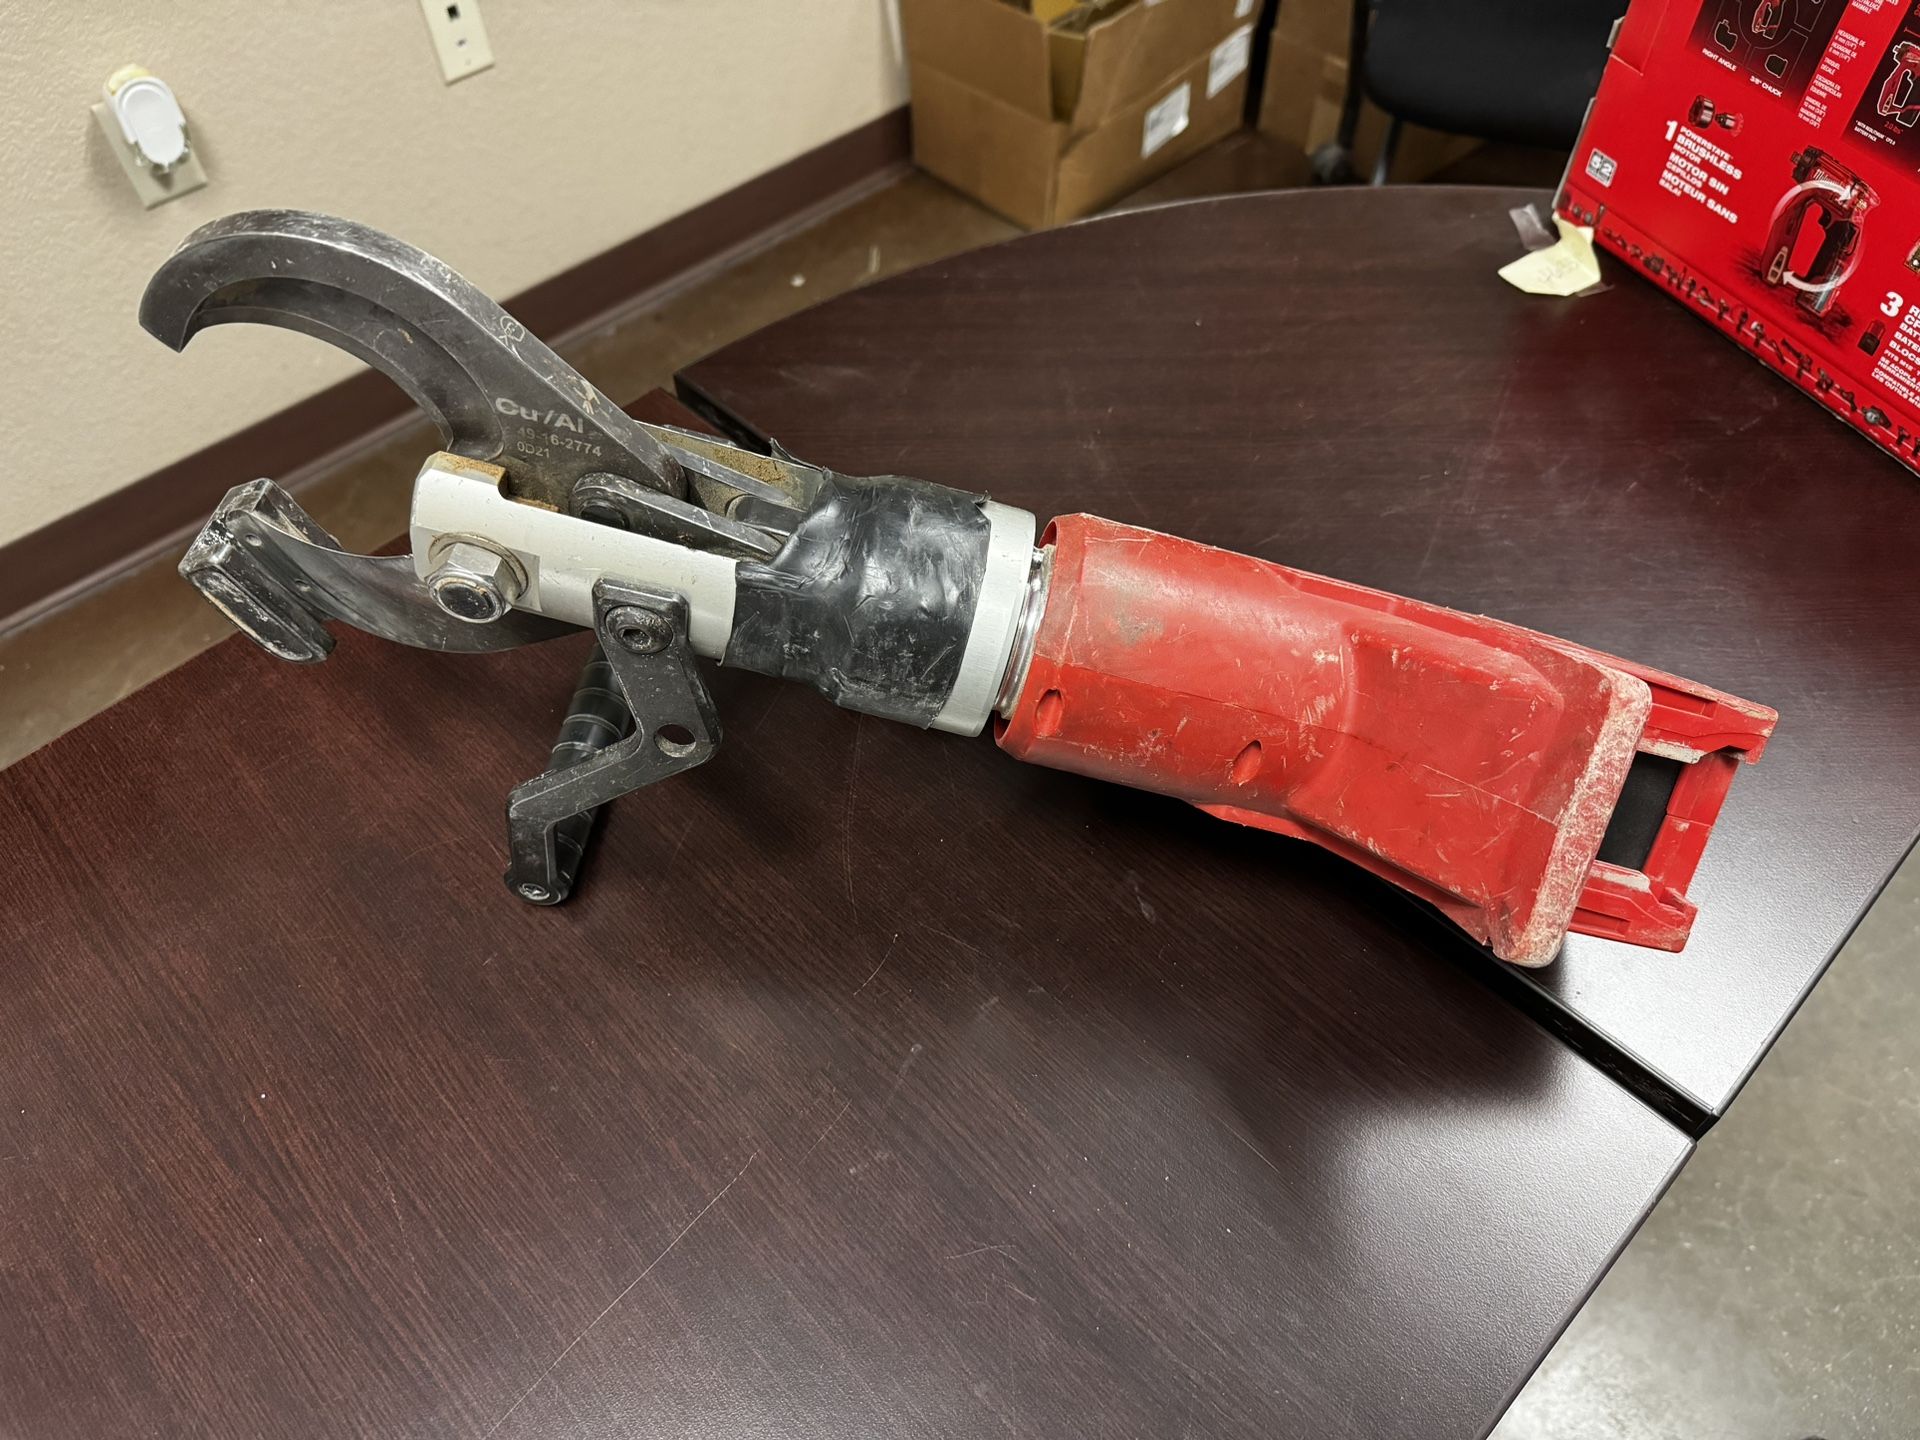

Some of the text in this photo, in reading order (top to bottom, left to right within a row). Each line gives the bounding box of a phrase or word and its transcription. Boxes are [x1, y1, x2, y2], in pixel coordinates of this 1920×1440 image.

[1702, 48, 1737, 72] RIGHT ANGLE
[1761, 82, 1782, 97] CHUCK
[1664, 120, 1678, 141] 1
[1673, 143, 1701, 164] MOTOR
[1676, 134, 1742, 180] BRUSHLESS
[1666, 161, 1702, 188] CEPILLOS
[1668, 152, 1729, 195] MOTOR SIN
[1659, 179, 1682, 197] BALAI
[1661, 169, 1738, 224] MOTEUR SANS
[1880, 291, 1904, 317] 3
[1884, 349, 1899, 362] FITS
[1871, 371, 1884, 383] LES
[1884, 380, 1909, 399] OUTILS
[1874, 368, 1915, 397] COMPATIBLE
[1890, 363, 1916, 383] ACOPLA
[495, 397, 584, 434] Cu/Al
